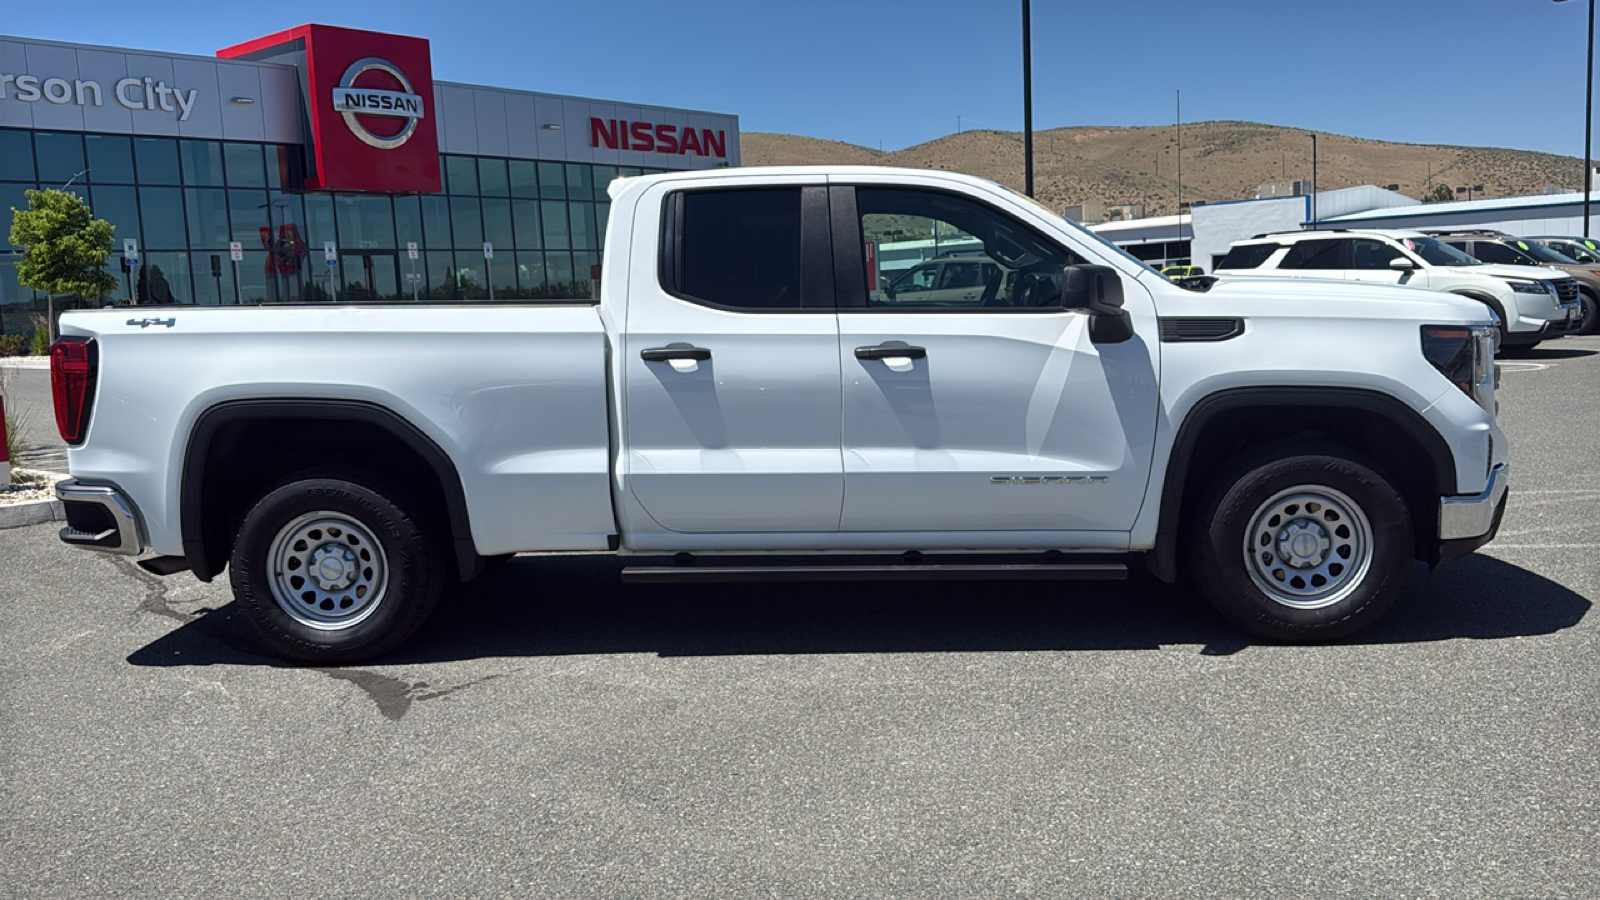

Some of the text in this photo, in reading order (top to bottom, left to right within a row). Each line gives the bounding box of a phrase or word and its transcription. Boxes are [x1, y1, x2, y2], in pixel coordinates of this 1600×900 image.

[115, 76, 198, 121] City
[344, 92, 419, 114] NISSAN
[590, 117, 726, 158] NISSAN
[359, 240, 378, 248] 2750
